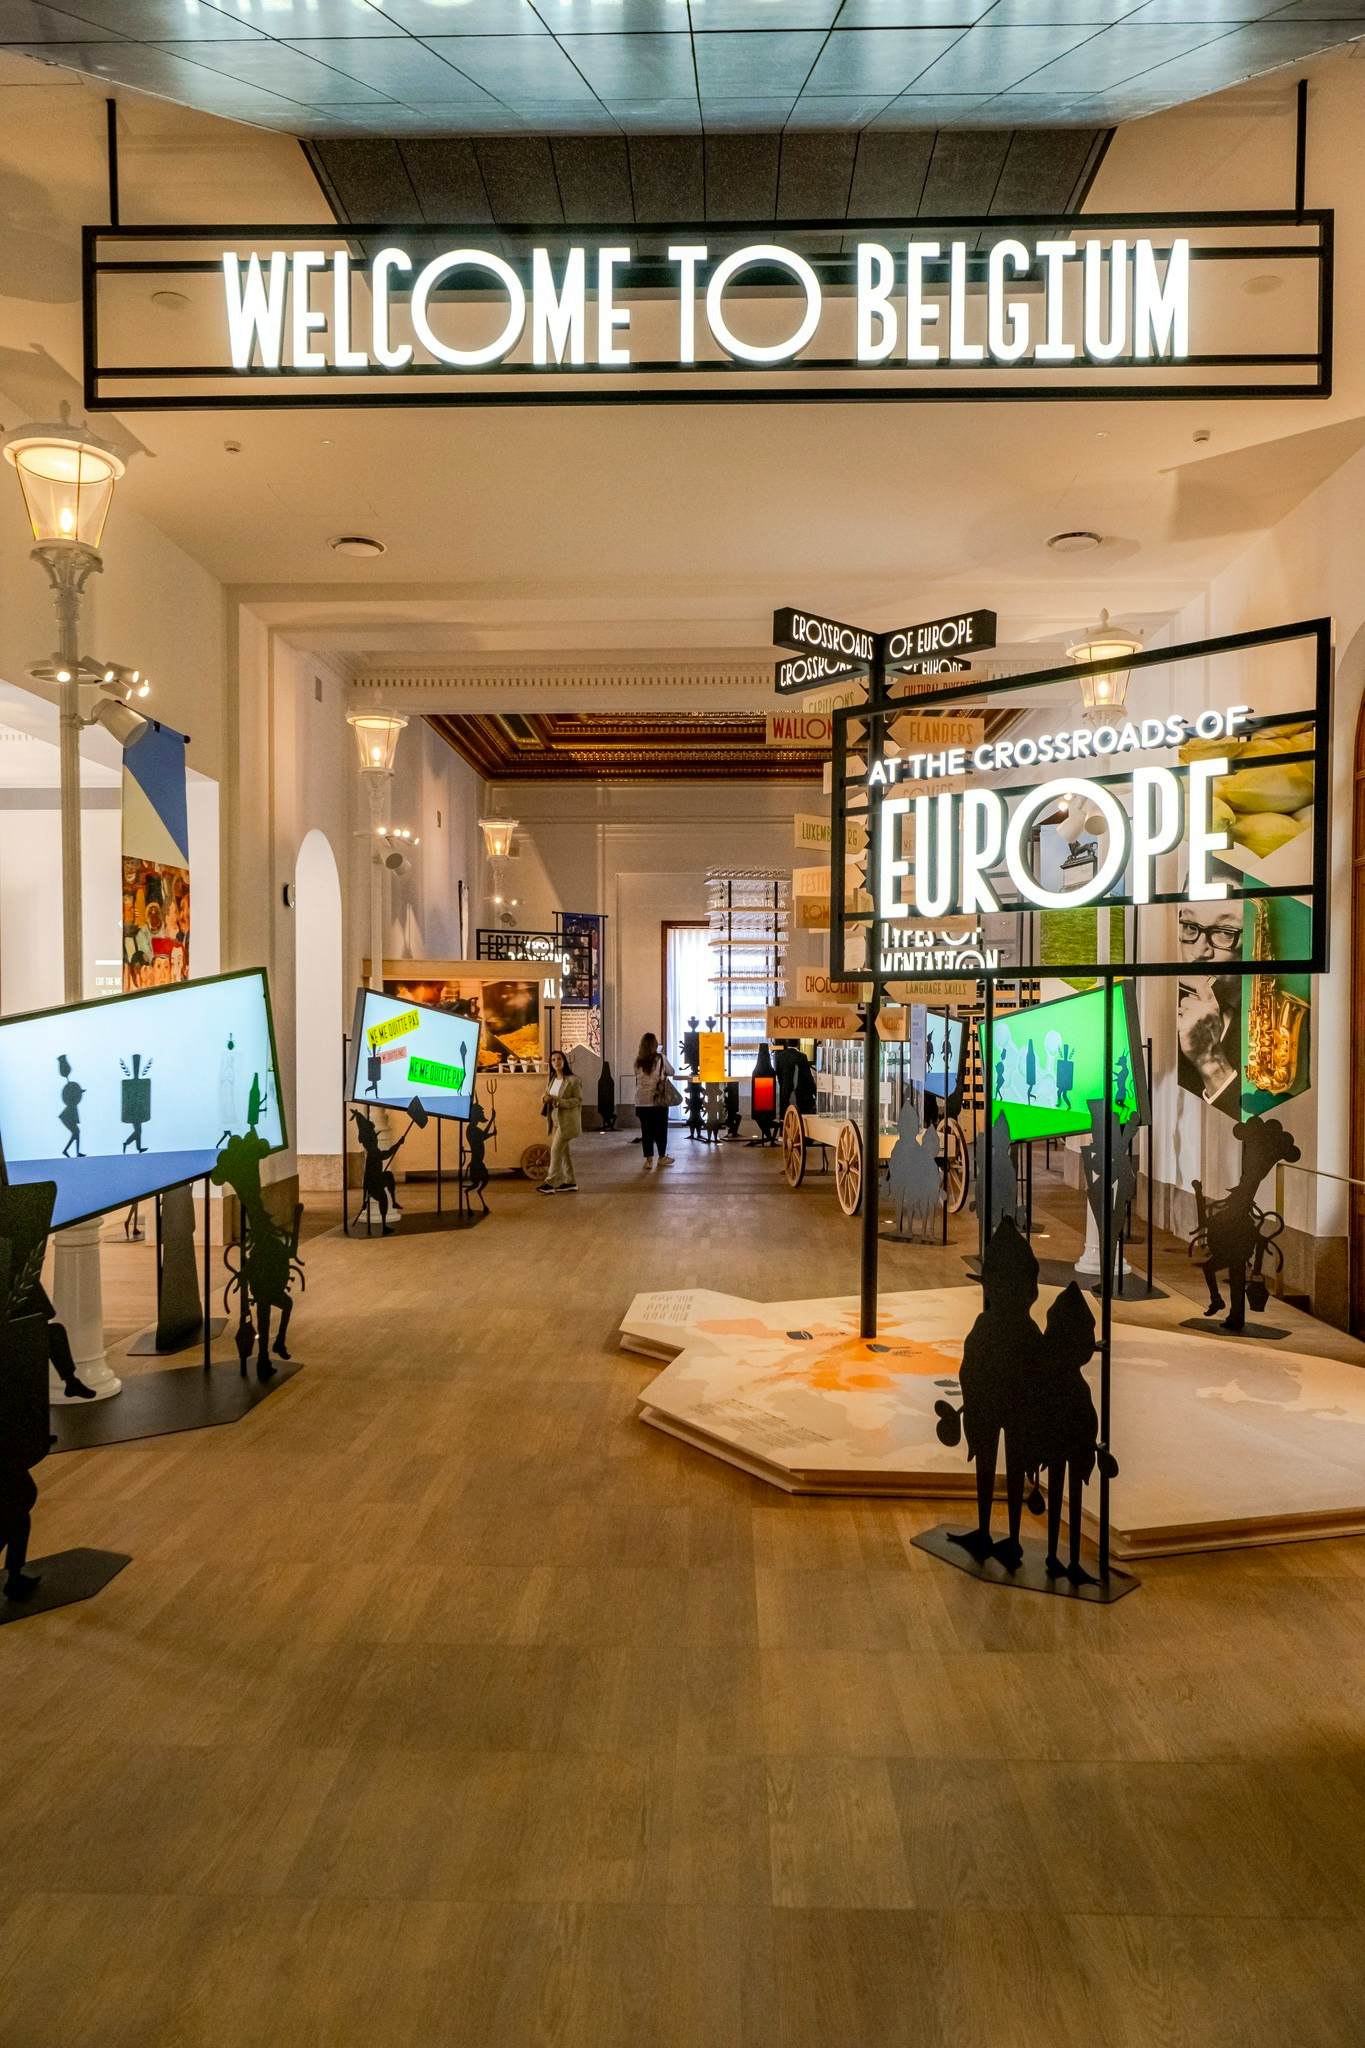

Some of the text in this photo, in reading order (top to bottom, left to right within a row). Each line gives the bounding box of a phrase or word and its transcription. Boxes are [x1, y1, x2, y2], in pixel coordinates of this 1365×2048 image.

[222, 239, 1190, 369] WELCOME TO BELGIUM
[792, 614, 973, 660] CROSSROADS OF EUROPE
[867, 705, 1250, 786] AT THE CROSSROADS OF
[910, 721, 974, 745] FLANDERS
[802, 822, 858, 847] LUXEMBRG
[879, 757, 1230, 919] EUROPE
[805, 976, 857, 994] CHOCOLATE
[905, 982, 967, 996] LANGUAGE SKILLS
[369, 1029, 379, 1043] NE
[379, 1025, 388, 1039] ME
[408, 1012, 420, 1029] PAS
[773, 1016, 846, 1030] NORTHERN AFRICA
[410, 1061, 419, 1076] NE
[420, 1063, 429, 1079] ME
[429, 1065, 451, 1085] QUITTE
